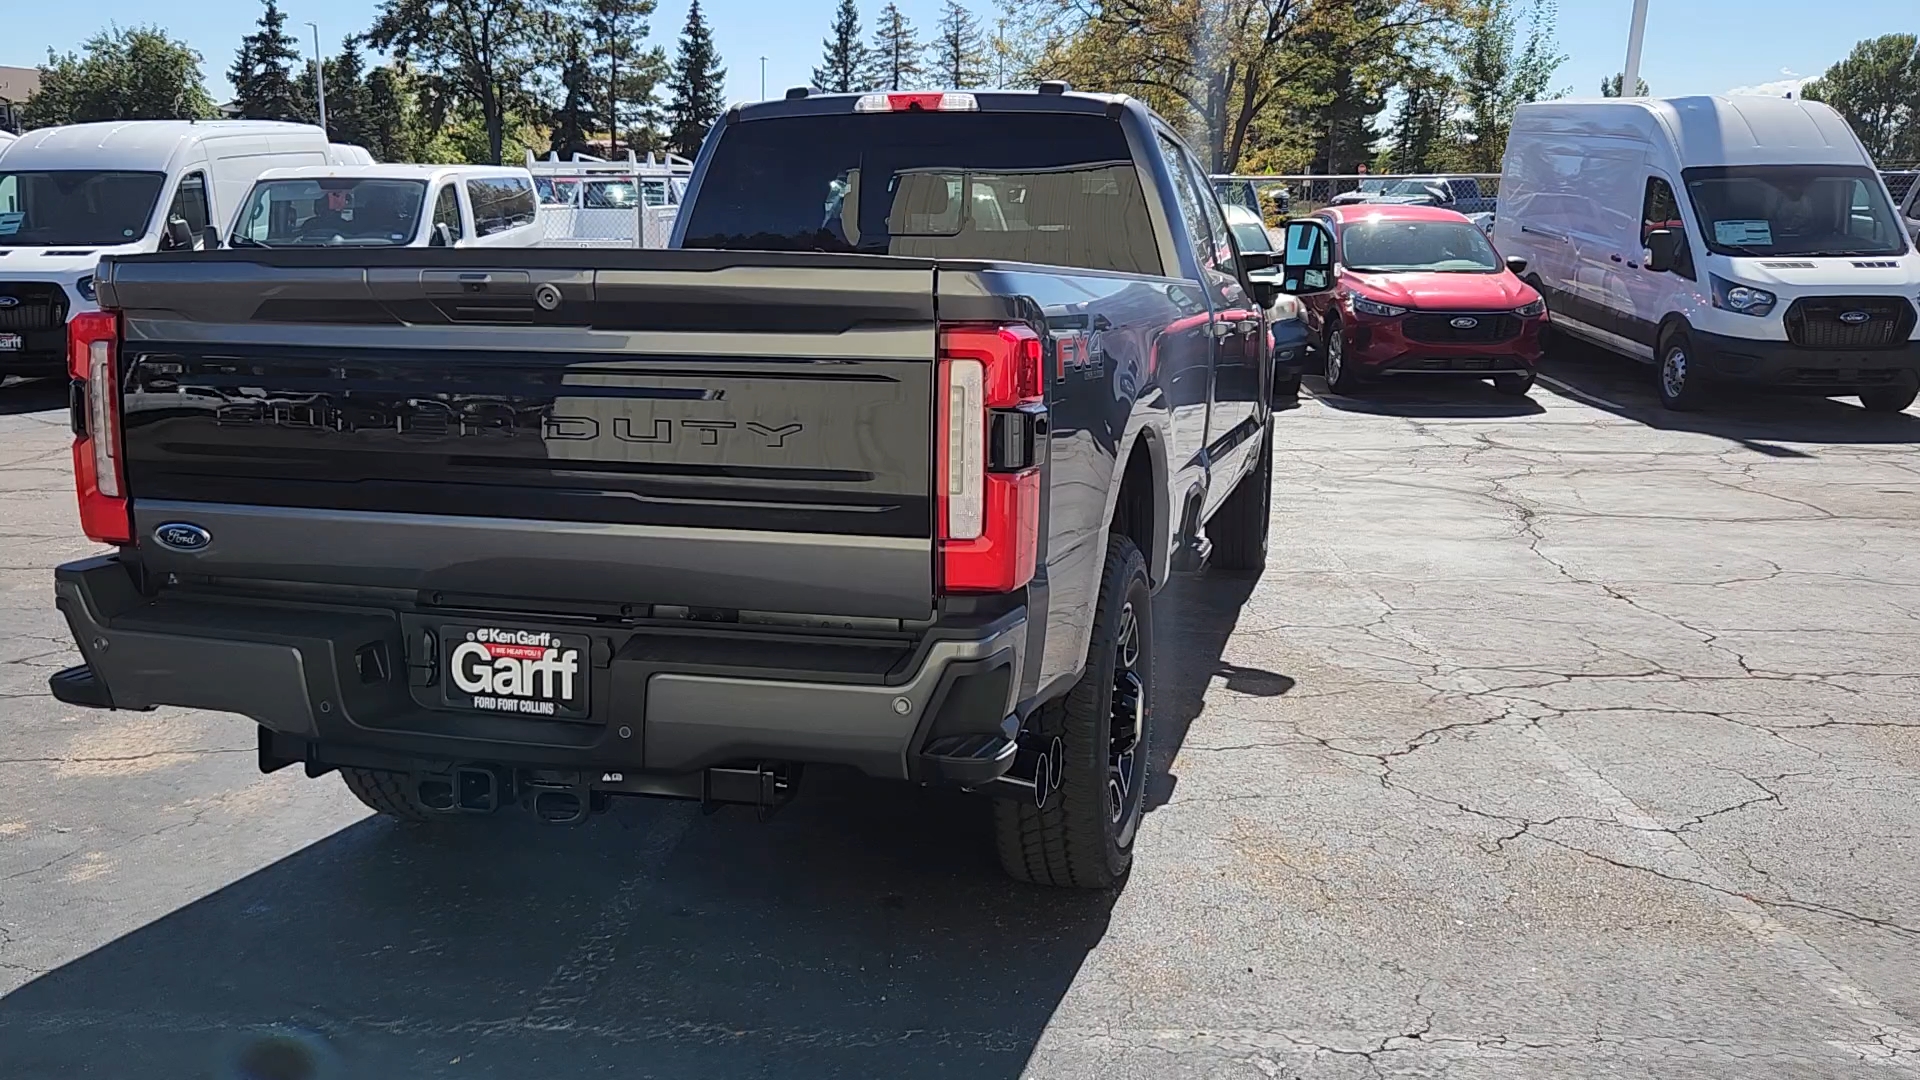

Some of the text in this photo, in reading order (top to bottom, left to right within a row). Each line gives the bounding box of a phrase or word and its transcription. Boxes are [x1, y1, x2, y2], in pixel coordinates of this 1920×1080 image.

[0, 335, 22, 349] arff
[1056, 330, 1104, 384] FX4
[541, 415, 803, 448] DUTY
[489, 629, 551, 647] Ken Garff
[506, 647, 524, 656] HEAR
[523, 649, 537, 657] YOU
[451, 641, 578, 700] Garff
[474, 696, 554, 715] FORD FORT COLLINS
